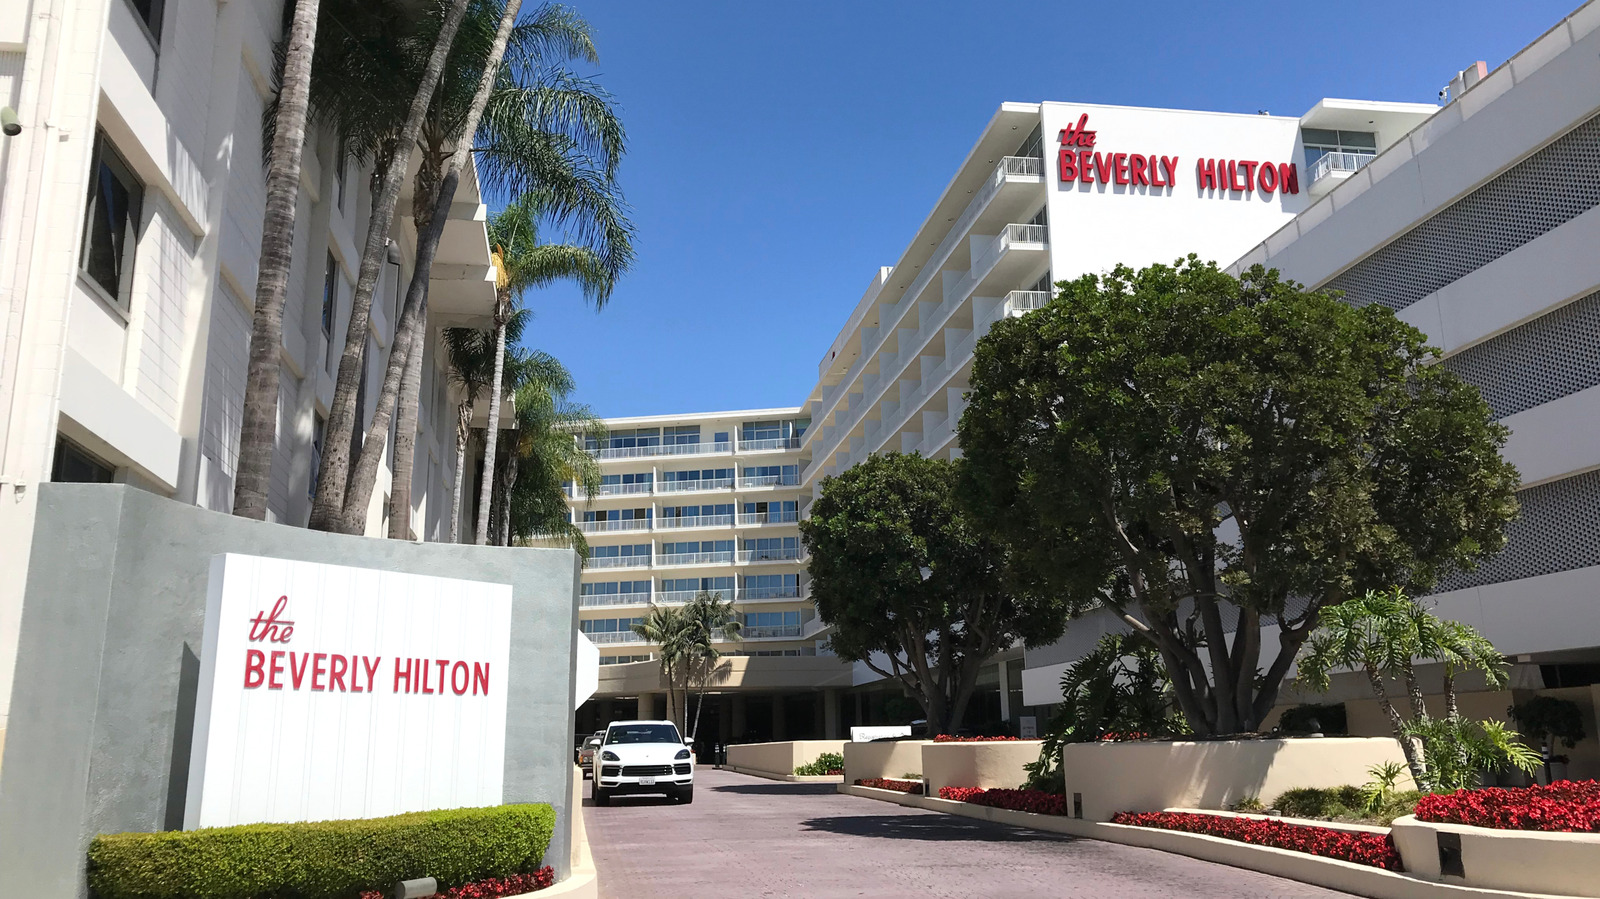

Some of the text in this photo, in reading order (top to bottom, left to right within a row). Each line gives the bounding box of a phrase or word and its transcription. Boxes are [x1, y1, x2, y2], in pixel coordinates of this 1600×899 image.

[1058, 113, 1097, 147] the
[1059, 149, 1299, 194] BEVERLY HILTON
[248, 595, 295, 643] the
[243, 649, 490, 696] BEVERLY HILTON
